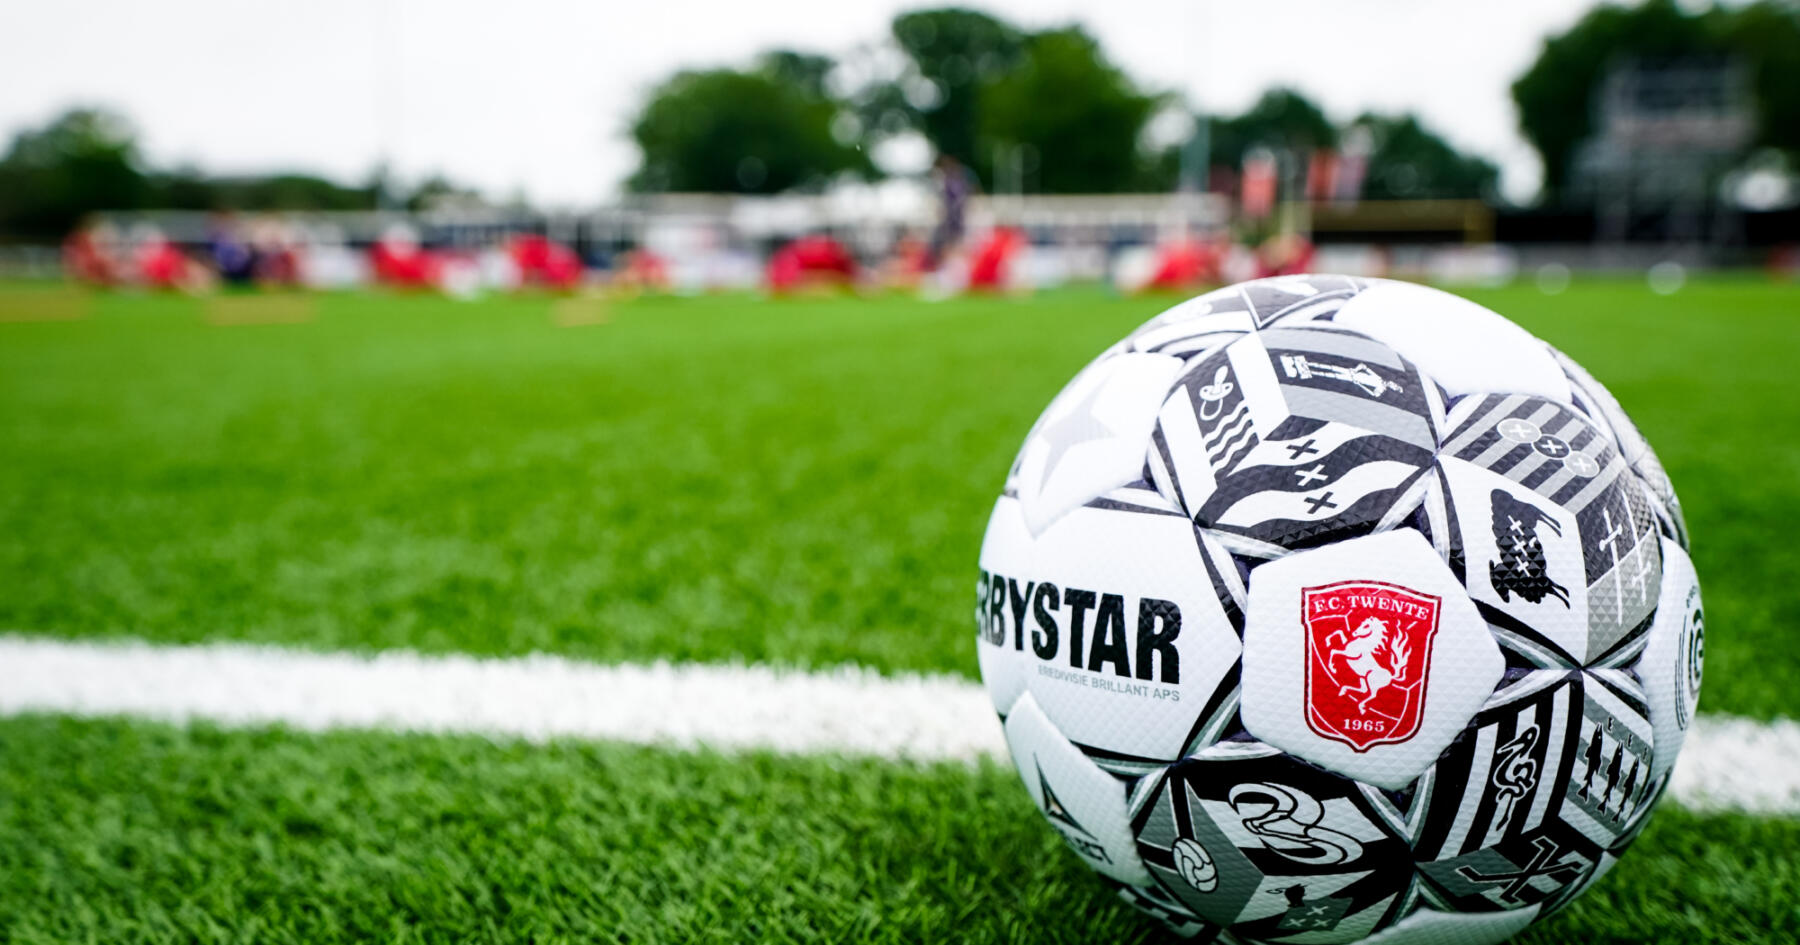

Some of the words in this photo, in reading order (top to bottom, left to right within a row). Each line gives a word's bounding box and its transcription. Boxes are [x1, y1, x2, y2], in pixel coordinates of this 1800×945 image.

[1313, 597, 1345, 613] F.C.
[1347, 595, 1430, 621] TWENTE
[977, 570, 1182, 684] RBYSTAR
[1037, 664, 1089, 687] EREDIVISIE
[1091, 676, 1149, 698] BRILLANT
[1152, 687, 1181, 702] APS
[1343, 718, 1385, 732] 1965
